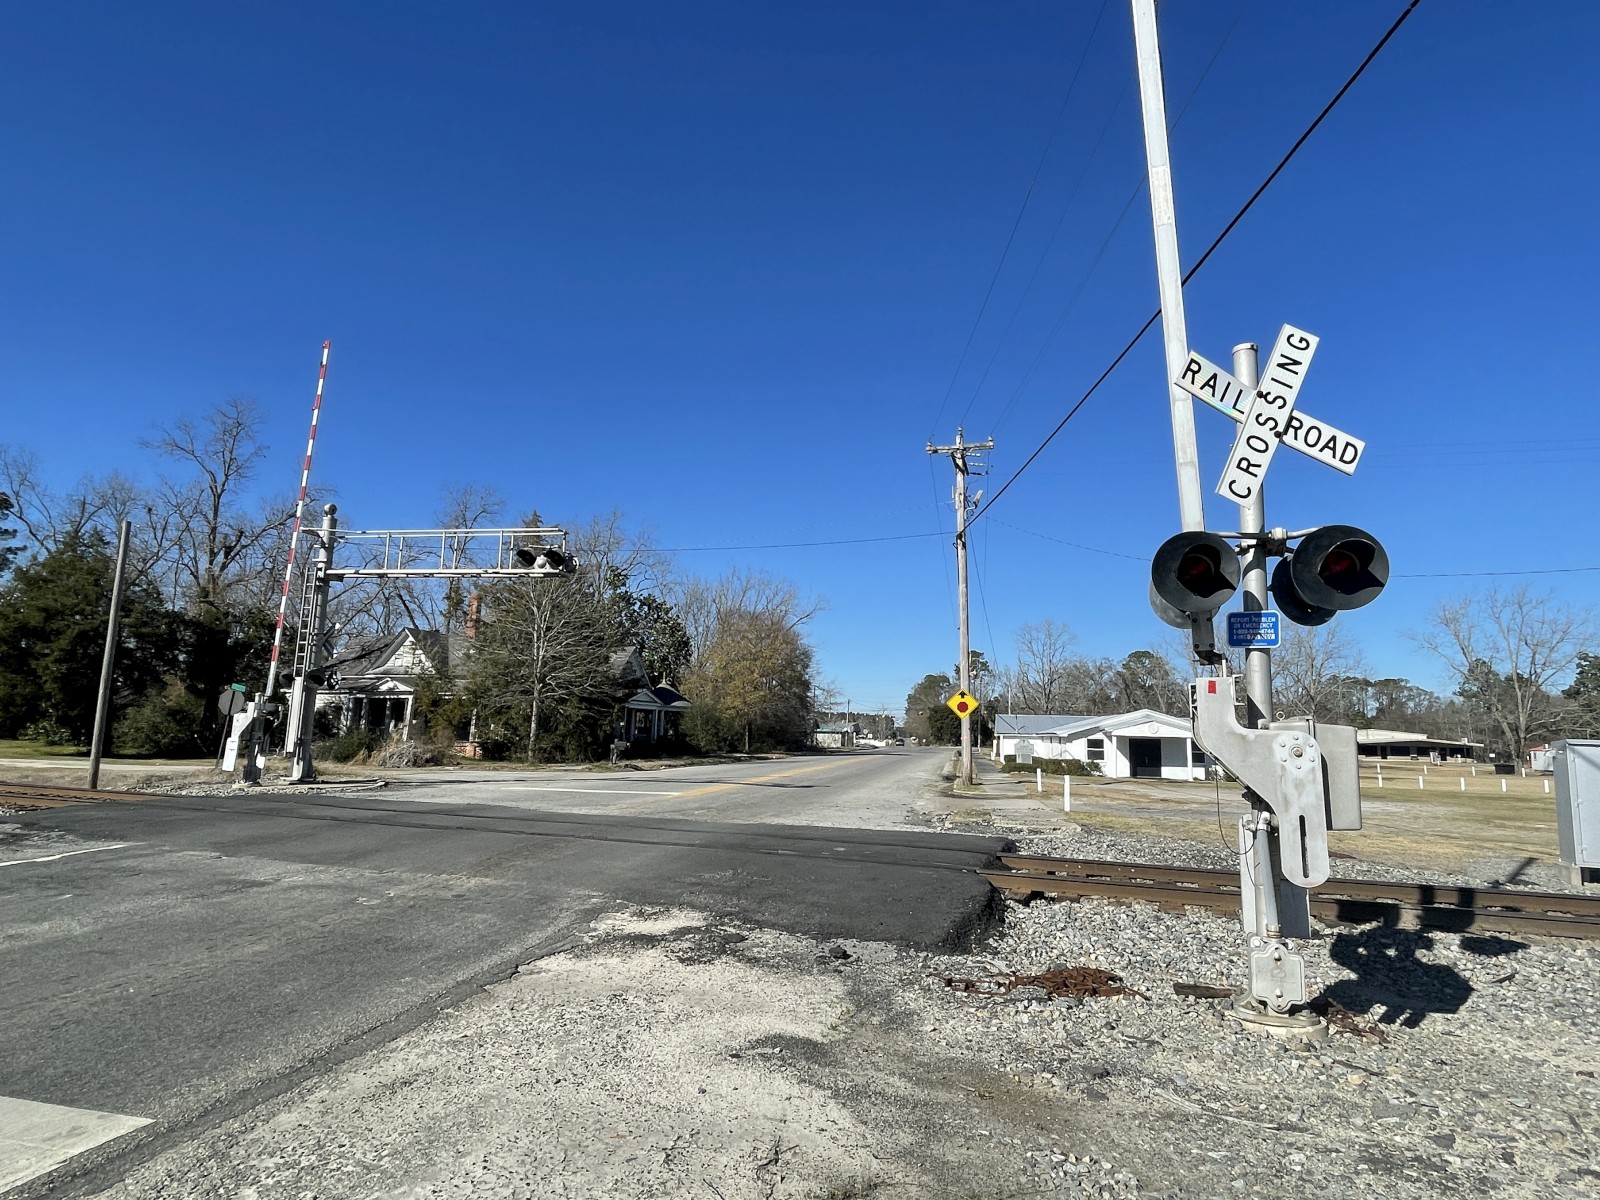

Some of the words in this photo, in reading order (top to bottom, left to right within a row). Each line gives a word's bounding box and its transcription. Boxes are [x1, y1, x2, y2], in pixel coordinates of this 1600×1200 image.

[1181, 357, 1245, 415] RAIL
[1284, 415, 1358, 465] ROAD
[1228, 333, 1311, 499] CROSSING
